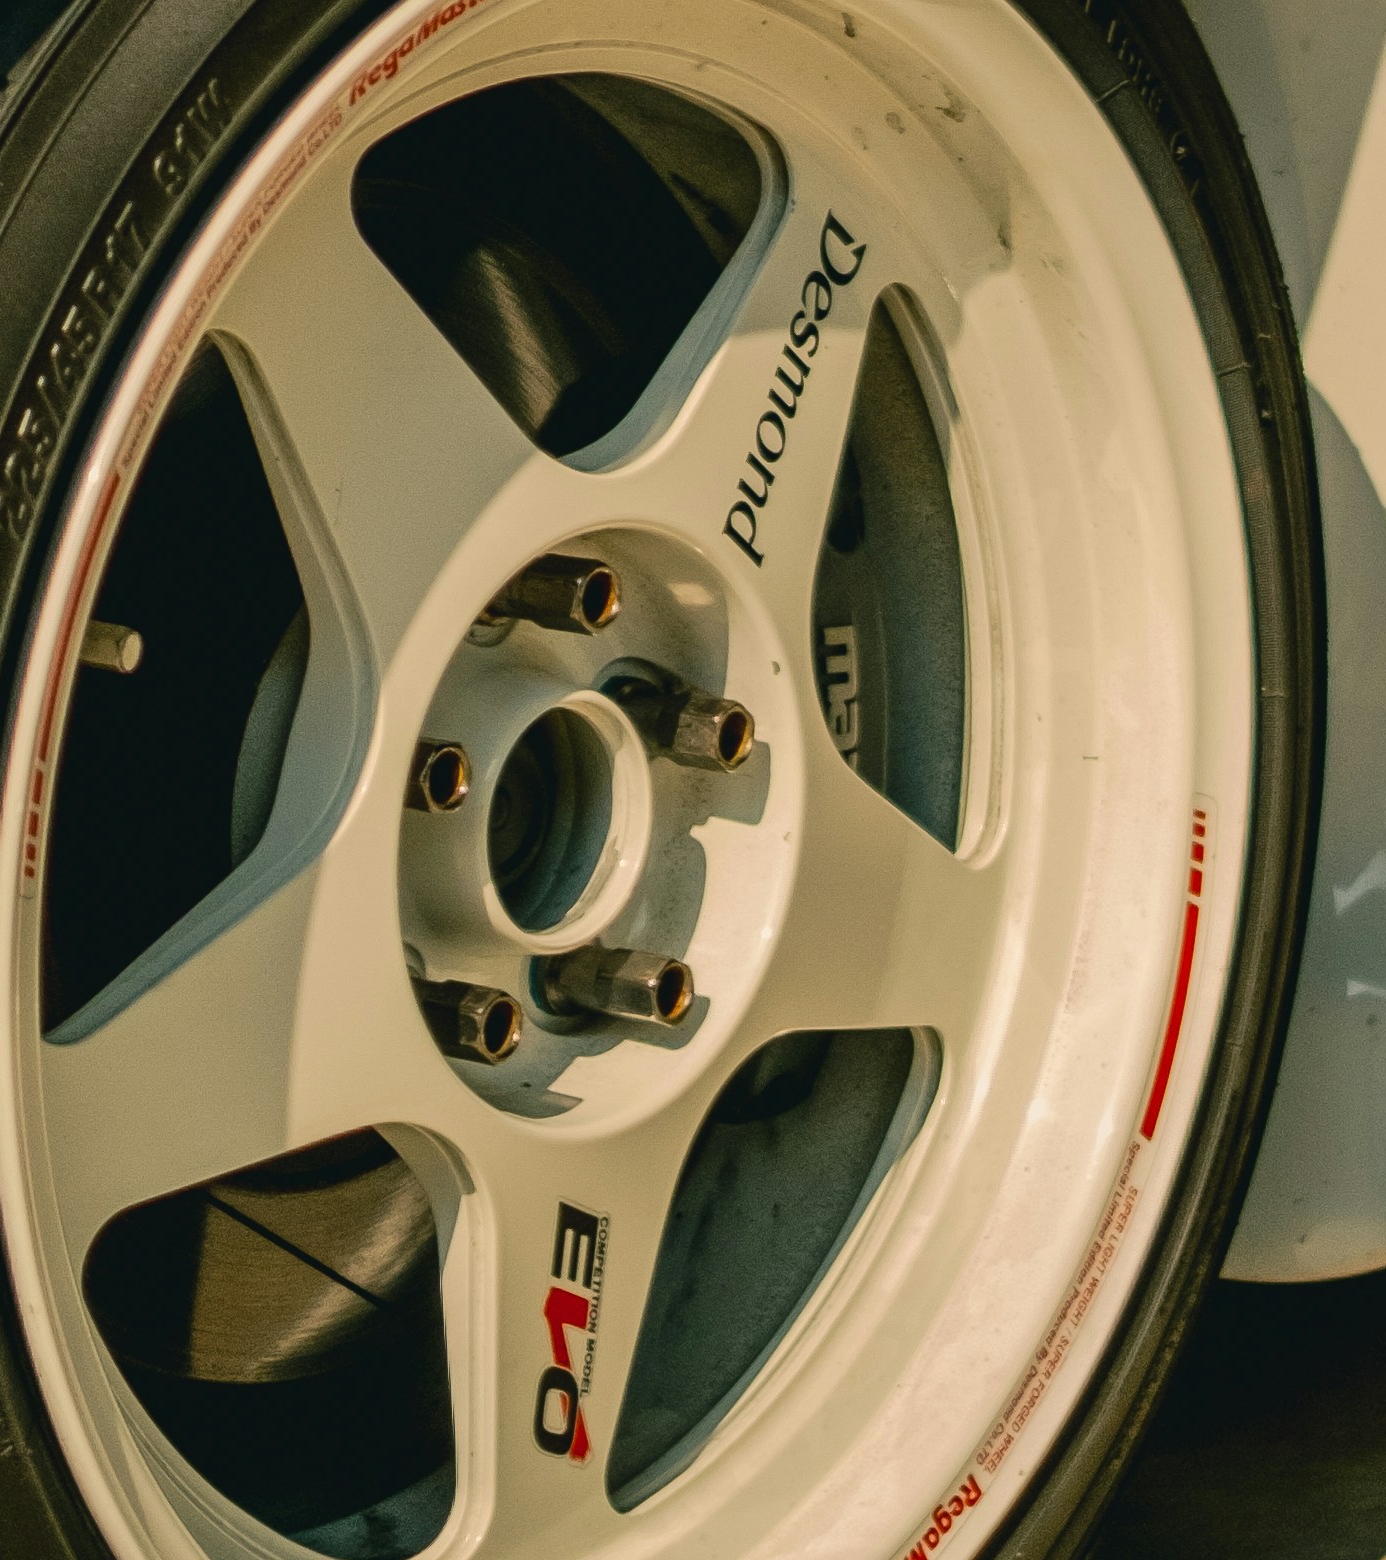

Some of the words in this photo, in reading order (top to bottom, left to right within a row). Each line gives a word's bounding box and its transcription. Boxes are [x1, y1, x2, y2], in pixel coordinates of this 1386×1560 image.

[723, 209, 866, 568] Desmond
[824, 625, 859, 772] ma
[587, 1216, 609, 1333] COMPETITION
[580, 1337, 598, 1398] MODEL
